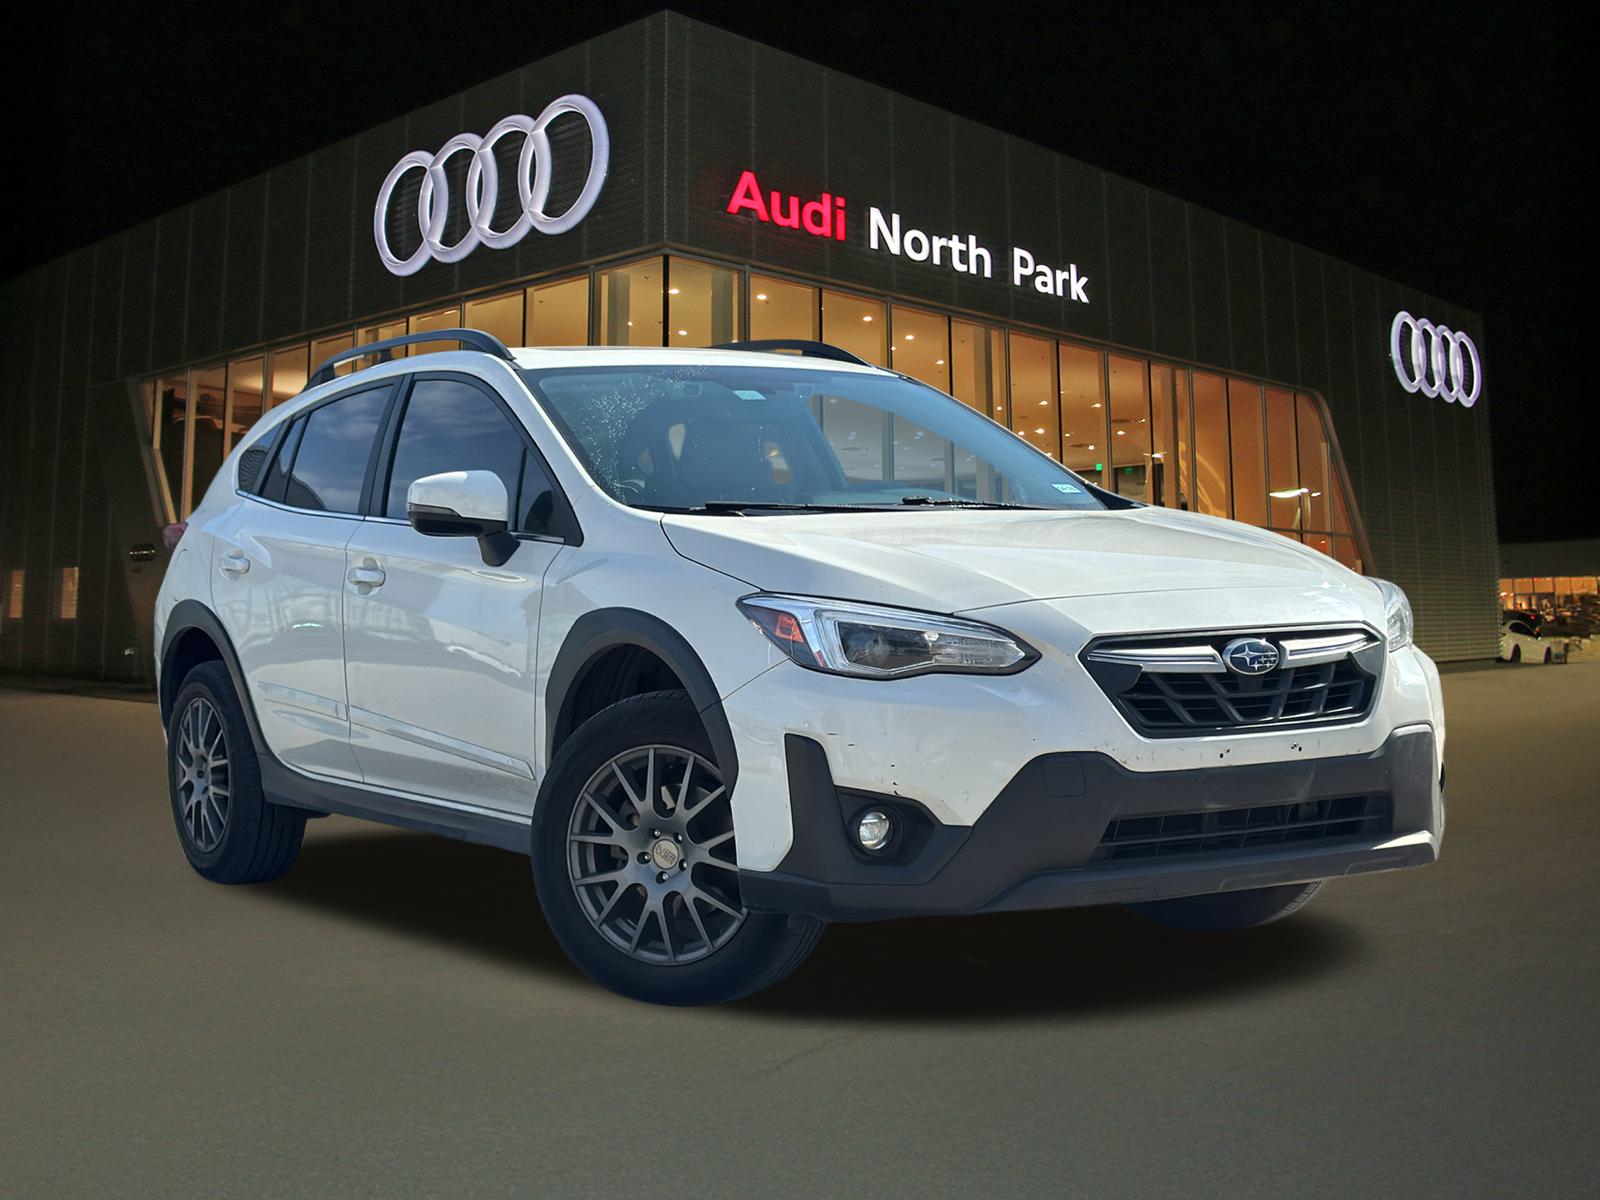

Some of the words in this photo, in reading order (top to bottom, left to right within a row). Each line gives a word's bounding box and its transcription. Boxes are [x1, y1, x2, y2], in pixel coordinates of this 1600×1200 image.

[726, 171, 846, 241] Audi
[869, 206, 992, 278] North
[1013, 247, 1090, 303] Park
